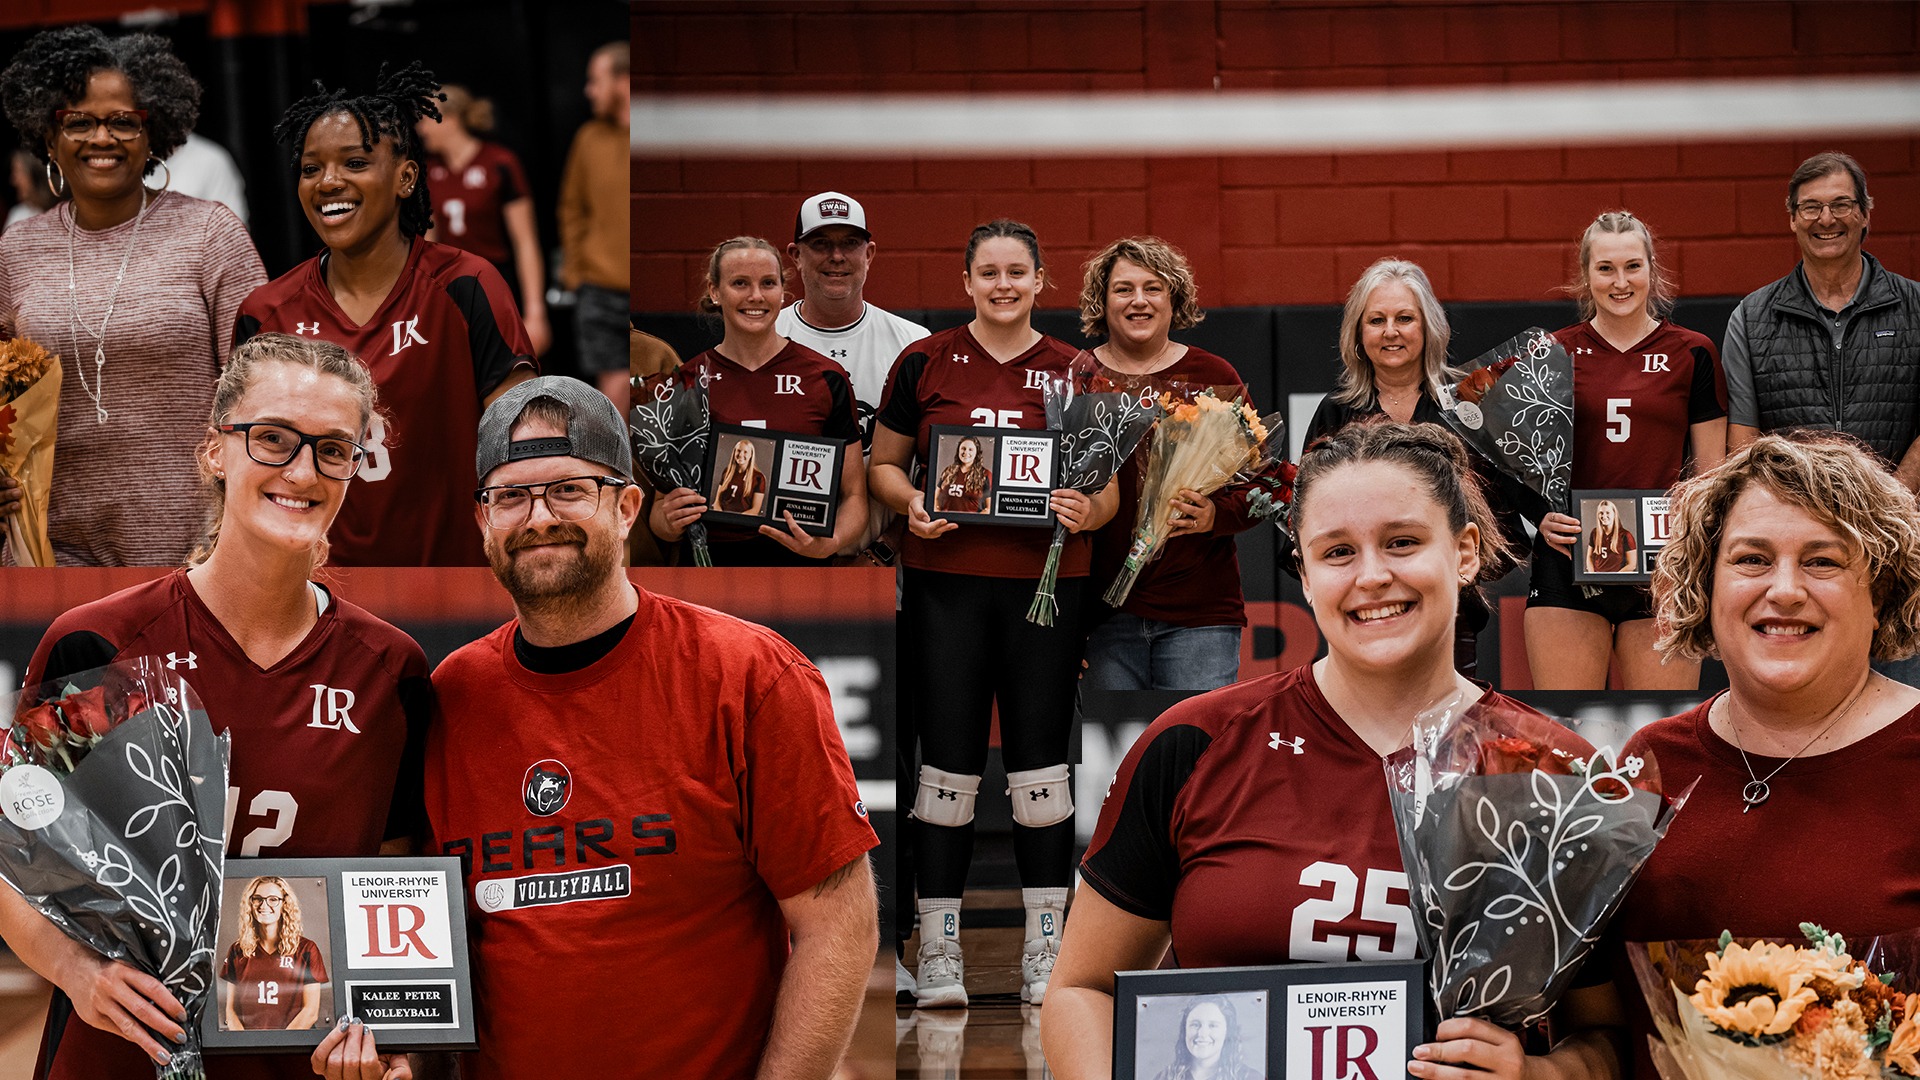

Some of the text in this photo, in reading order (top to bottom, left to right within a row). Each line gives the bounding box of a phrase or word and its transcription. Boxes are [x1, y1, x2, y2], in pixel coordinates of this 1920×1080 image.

[389, 314, 429, 356] LR
[1642, 353, 1671, 373] LR
[774, 374, 805, 396] LR
[1463, 412, 1480, 422] ROSE
[1606, 398, 1632, 443] 5
[787, 443, 832, 454] LENOIR-RHYNE
[791, 450, 827, 459] UNIVERSITY
[786, 457, 823, 490] LR
[1006, 453, 1043, 484] LR
[730, 485, 738, 497] 7
[948, 484, 964, 498] 25
[792, 511, 815, 520] LLEYBALL
[1006, 505, 1038, 513] VOLLEYBALL
[1601, 547, 1608, 559] 5
[307, 684, 361, 734] LR
[12, 793, 55, 815] ROSE
[443, 813, 678, 874] BEARS
[351, 876, 439, 887] LENOIR-RHYNE
[518, 871, 625, 902] VOLLEYBALL
[361, 888, 431, 898] UNIVERSITY
[1289, 861, 1418, 963] 25
[359, 904, 439, 960] LR
[279, 956, 294, 969] LR
[257, 981, 279, 1005] 12
[362, 991, 441, 1001] KALEE PETER
[1297, 989, 1398, 1004] LENOIR-RHYNE
[365, 1008, 440, 1018] VOLLEYBALL
[1307, 1004, 1388, 1019] UNIVERSITY
[1303, 1024, 1380, 1080] LR
